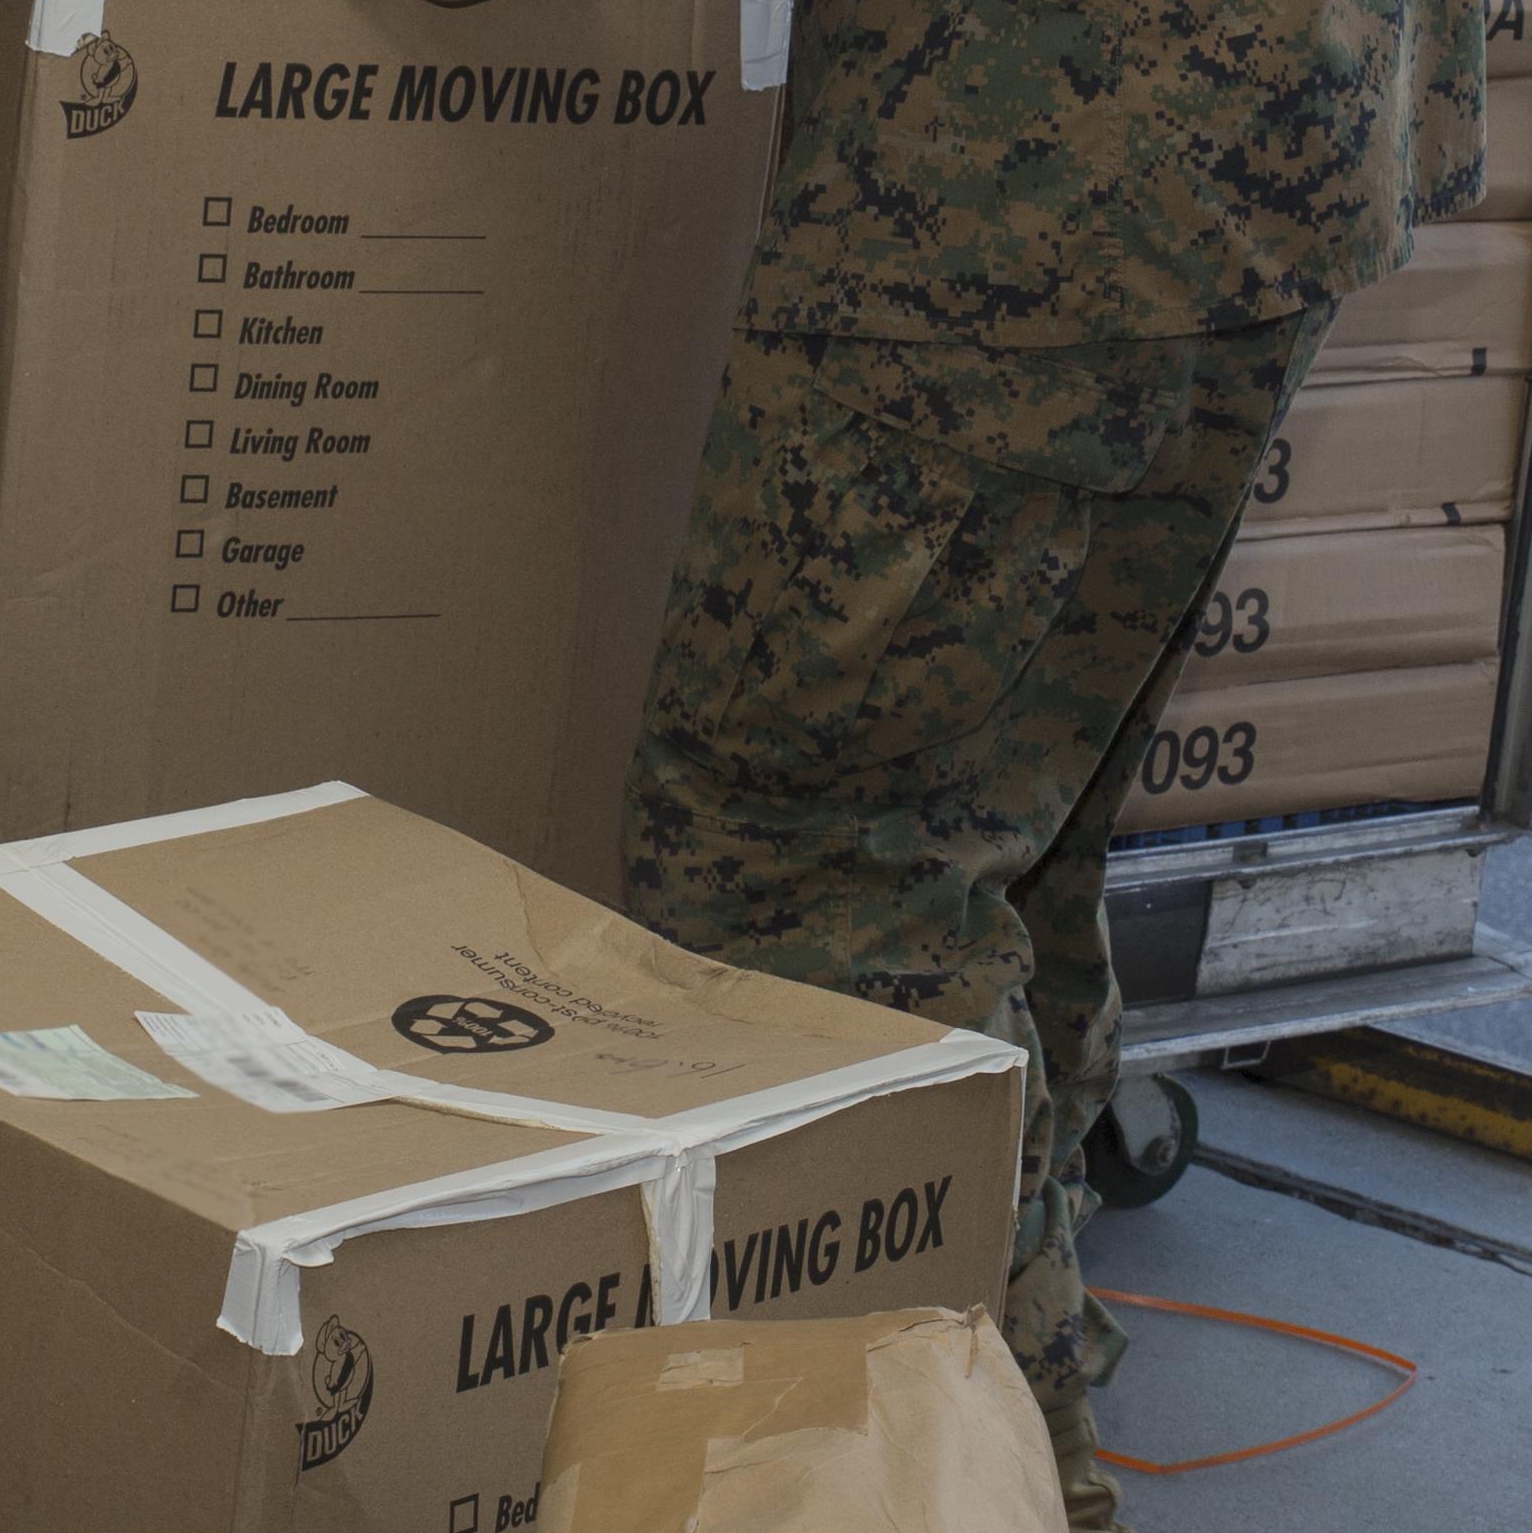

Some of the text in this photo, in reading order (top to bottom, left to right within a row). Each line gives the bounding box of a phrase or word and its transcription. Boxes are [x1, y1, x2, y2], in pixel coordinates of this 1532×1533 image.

[214, 61, 714, 127] LARGE MOVING BOX
[70, 101, 126, 133] DUCK
[247, 205, 349, 237] Bedroom
[242, 261, 355, 293] Bathroom
[238, 316, 323, 348] Kitchen
[234, 372, 380, 406] Dining Room
[229, 427, 371, 462] Living Room
[225, 482, 337, 509] Basement
[221, 538, 305, 571] Garage
[216, 591, 285, 619] Other
[1141, 721, 1257, 795] 093
[451, 944, 599, 1027] post-consumer
[494, 951, 573, 998] content
[452, 1015, 493, 1037] 100%
[634, 1210, 842, 1328] VING
[855, 1175, 953, 1273] BOX
[306, 1406, 364, 1463] DUCK
